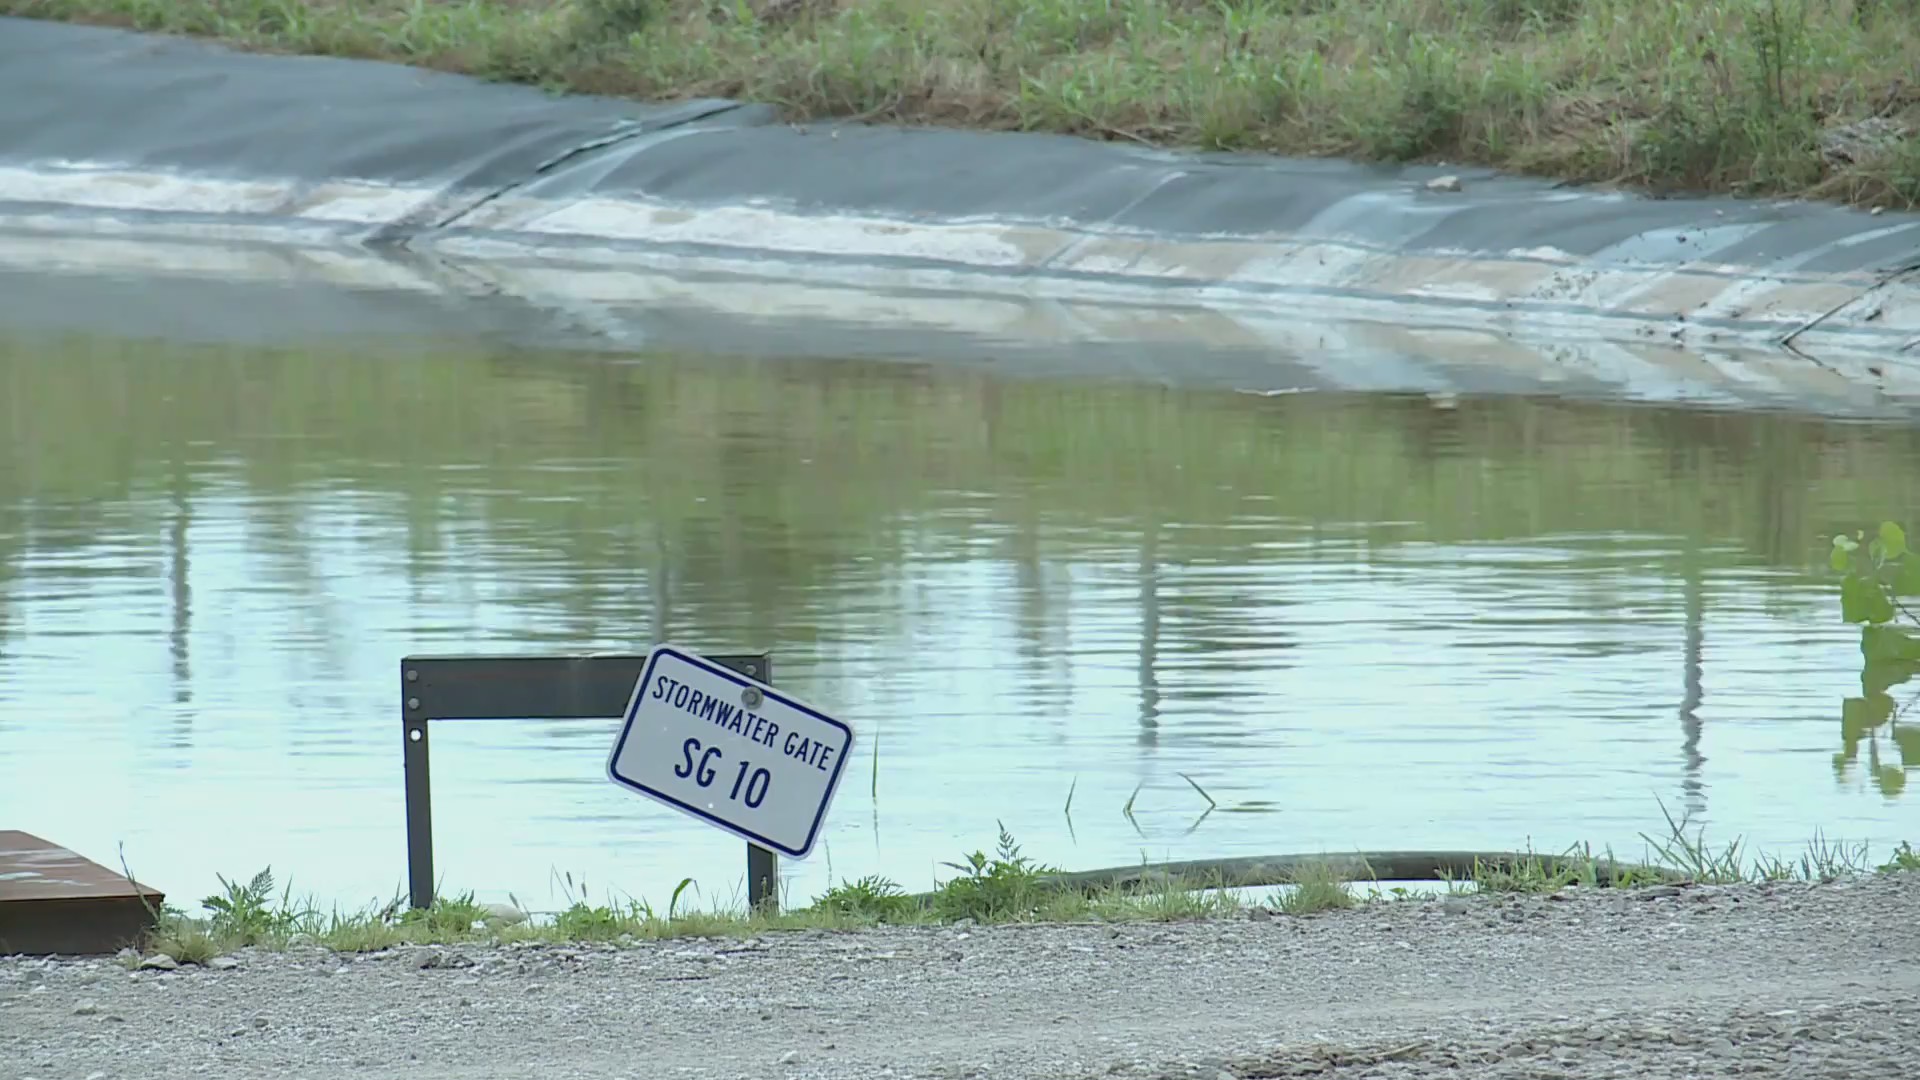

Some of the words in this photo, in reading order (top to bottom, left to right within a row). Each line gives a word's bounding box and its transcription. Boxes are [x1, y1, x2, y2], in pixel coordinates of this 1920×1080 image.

[652, 675, 780, 748] STORMWATER
[784, 732, 835, 771] GATE
[674, 737, 722, 788] SG
[729, 761, 771, 808] 10
